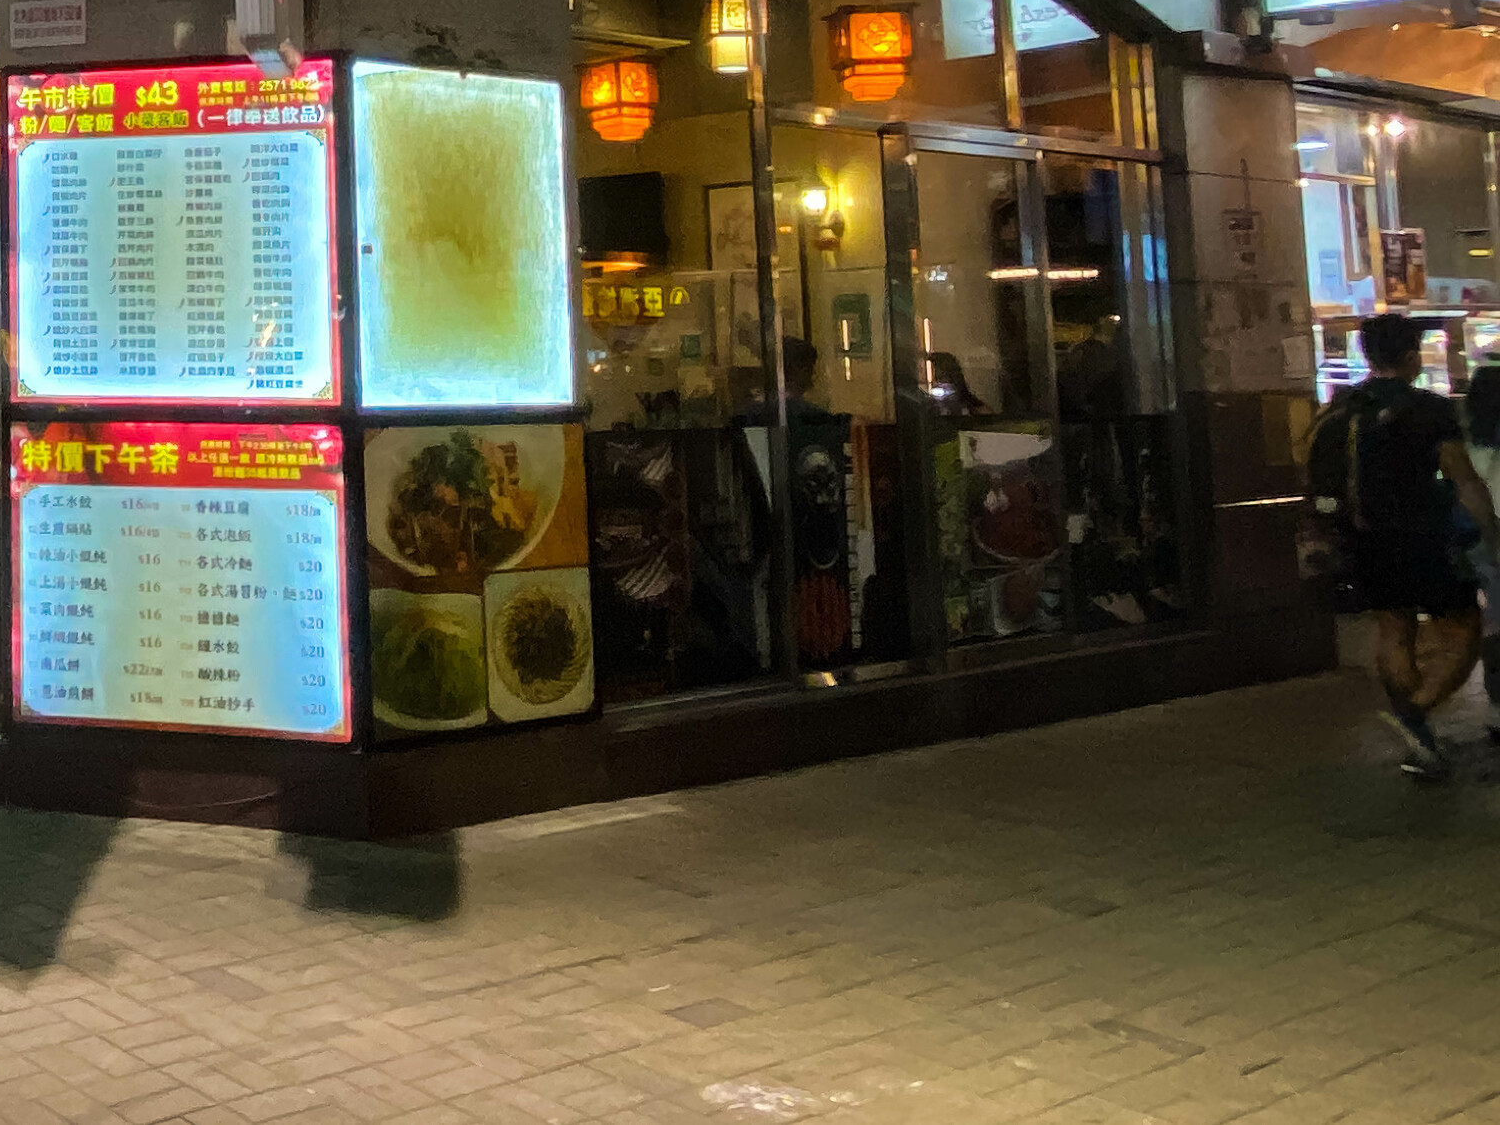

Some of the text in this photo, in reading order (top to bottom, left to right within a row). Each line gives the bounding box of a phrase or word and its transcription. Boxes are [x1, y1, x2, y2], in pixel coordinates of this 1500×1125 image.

[259, 78, 287, 93] 2571
[20, 81, 179, 110] 午市特價 $43
[22, 441, 180, 475] 特價下午茶
[40, 494, 92, 509] 手工水餃
[299, 561, 323, 573] $20
[300, 588, 324, 601] $20
[301, 617, 324, 629] $20
[302, 675, 326, 687] $20
